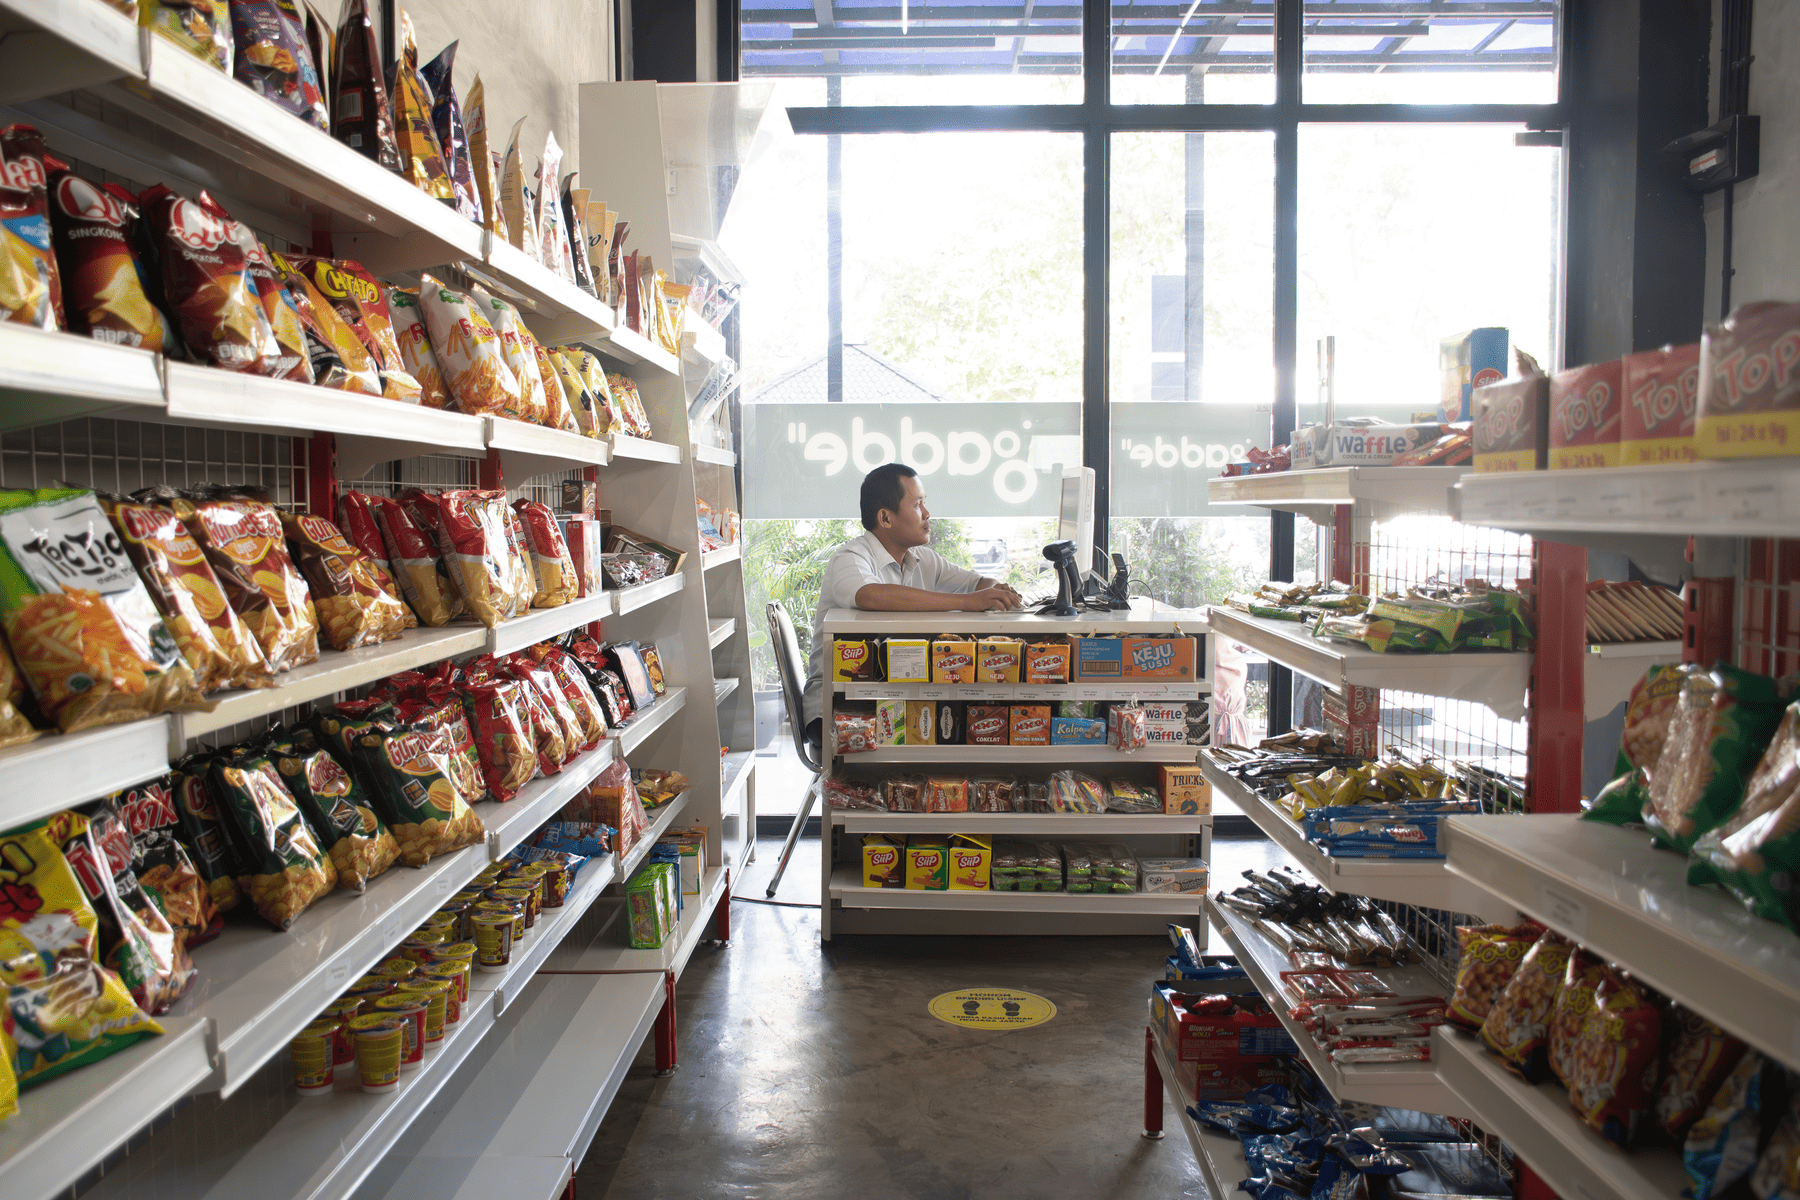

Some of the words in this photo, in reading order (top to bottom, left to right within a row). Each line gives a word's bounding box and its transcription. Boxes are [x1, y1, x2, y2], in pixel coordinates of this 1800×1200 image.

[1717, 329, 1800, 407] TOP
[1632, 364, 1700, 431] TOP
[1556, 381, 1611, 441] TOP
[1481, 395, 1525, 447] TOP
[1140, 657, 1172, 672] SUSU
[1172, 774, 1205, 787] TRICKS
[872, 852, 894, 865] SiiP
[916, 854, 938, 867] SiiP
[959, 854, 981, 868] SiiP
